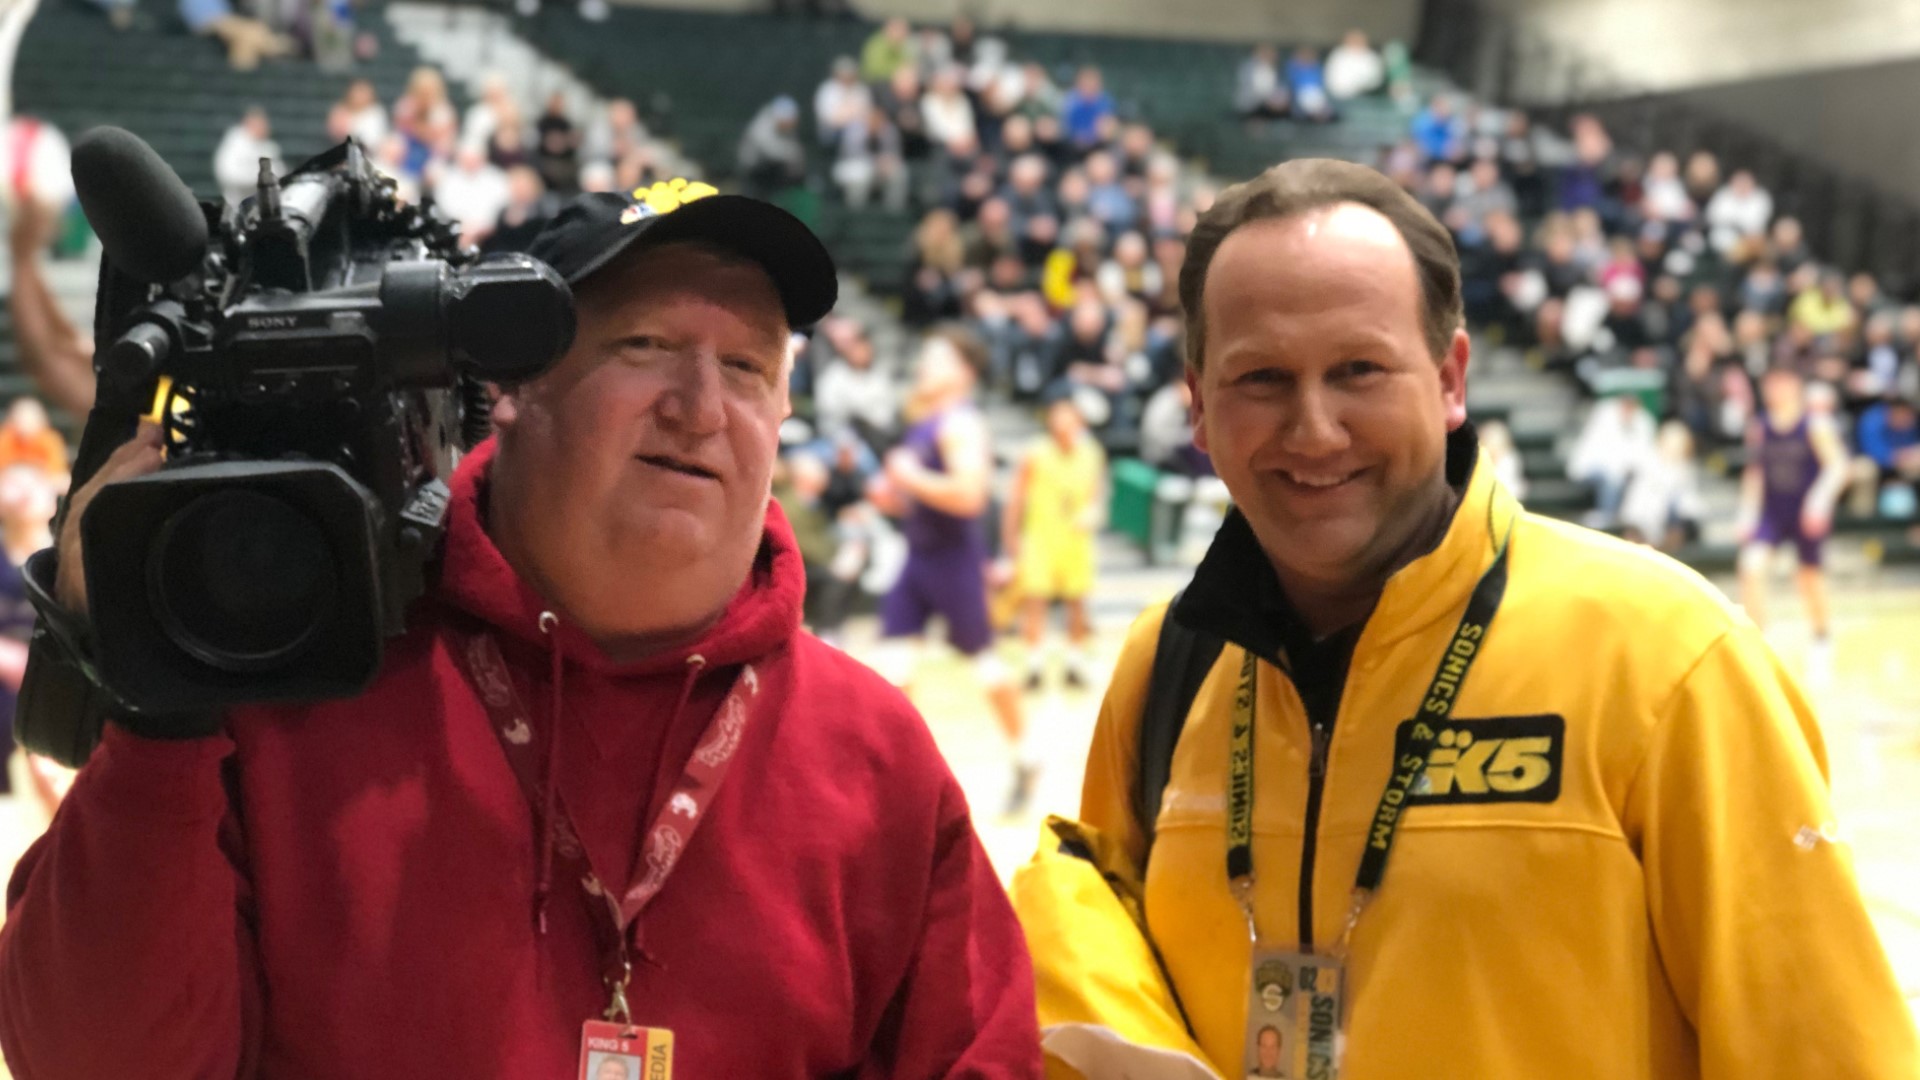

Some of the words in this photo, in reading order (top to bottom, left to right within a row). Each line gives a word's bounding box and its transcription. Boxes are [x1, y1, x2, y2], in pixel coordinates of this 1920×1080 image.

[247, 316, 297, 328] SONY
[1425, 622, 1483, 716] SONICS
[1411, 722, 1435, 741] &
[1371, 753, 1423, 850] STORM
[587, 1037, 618, 1051] KING
